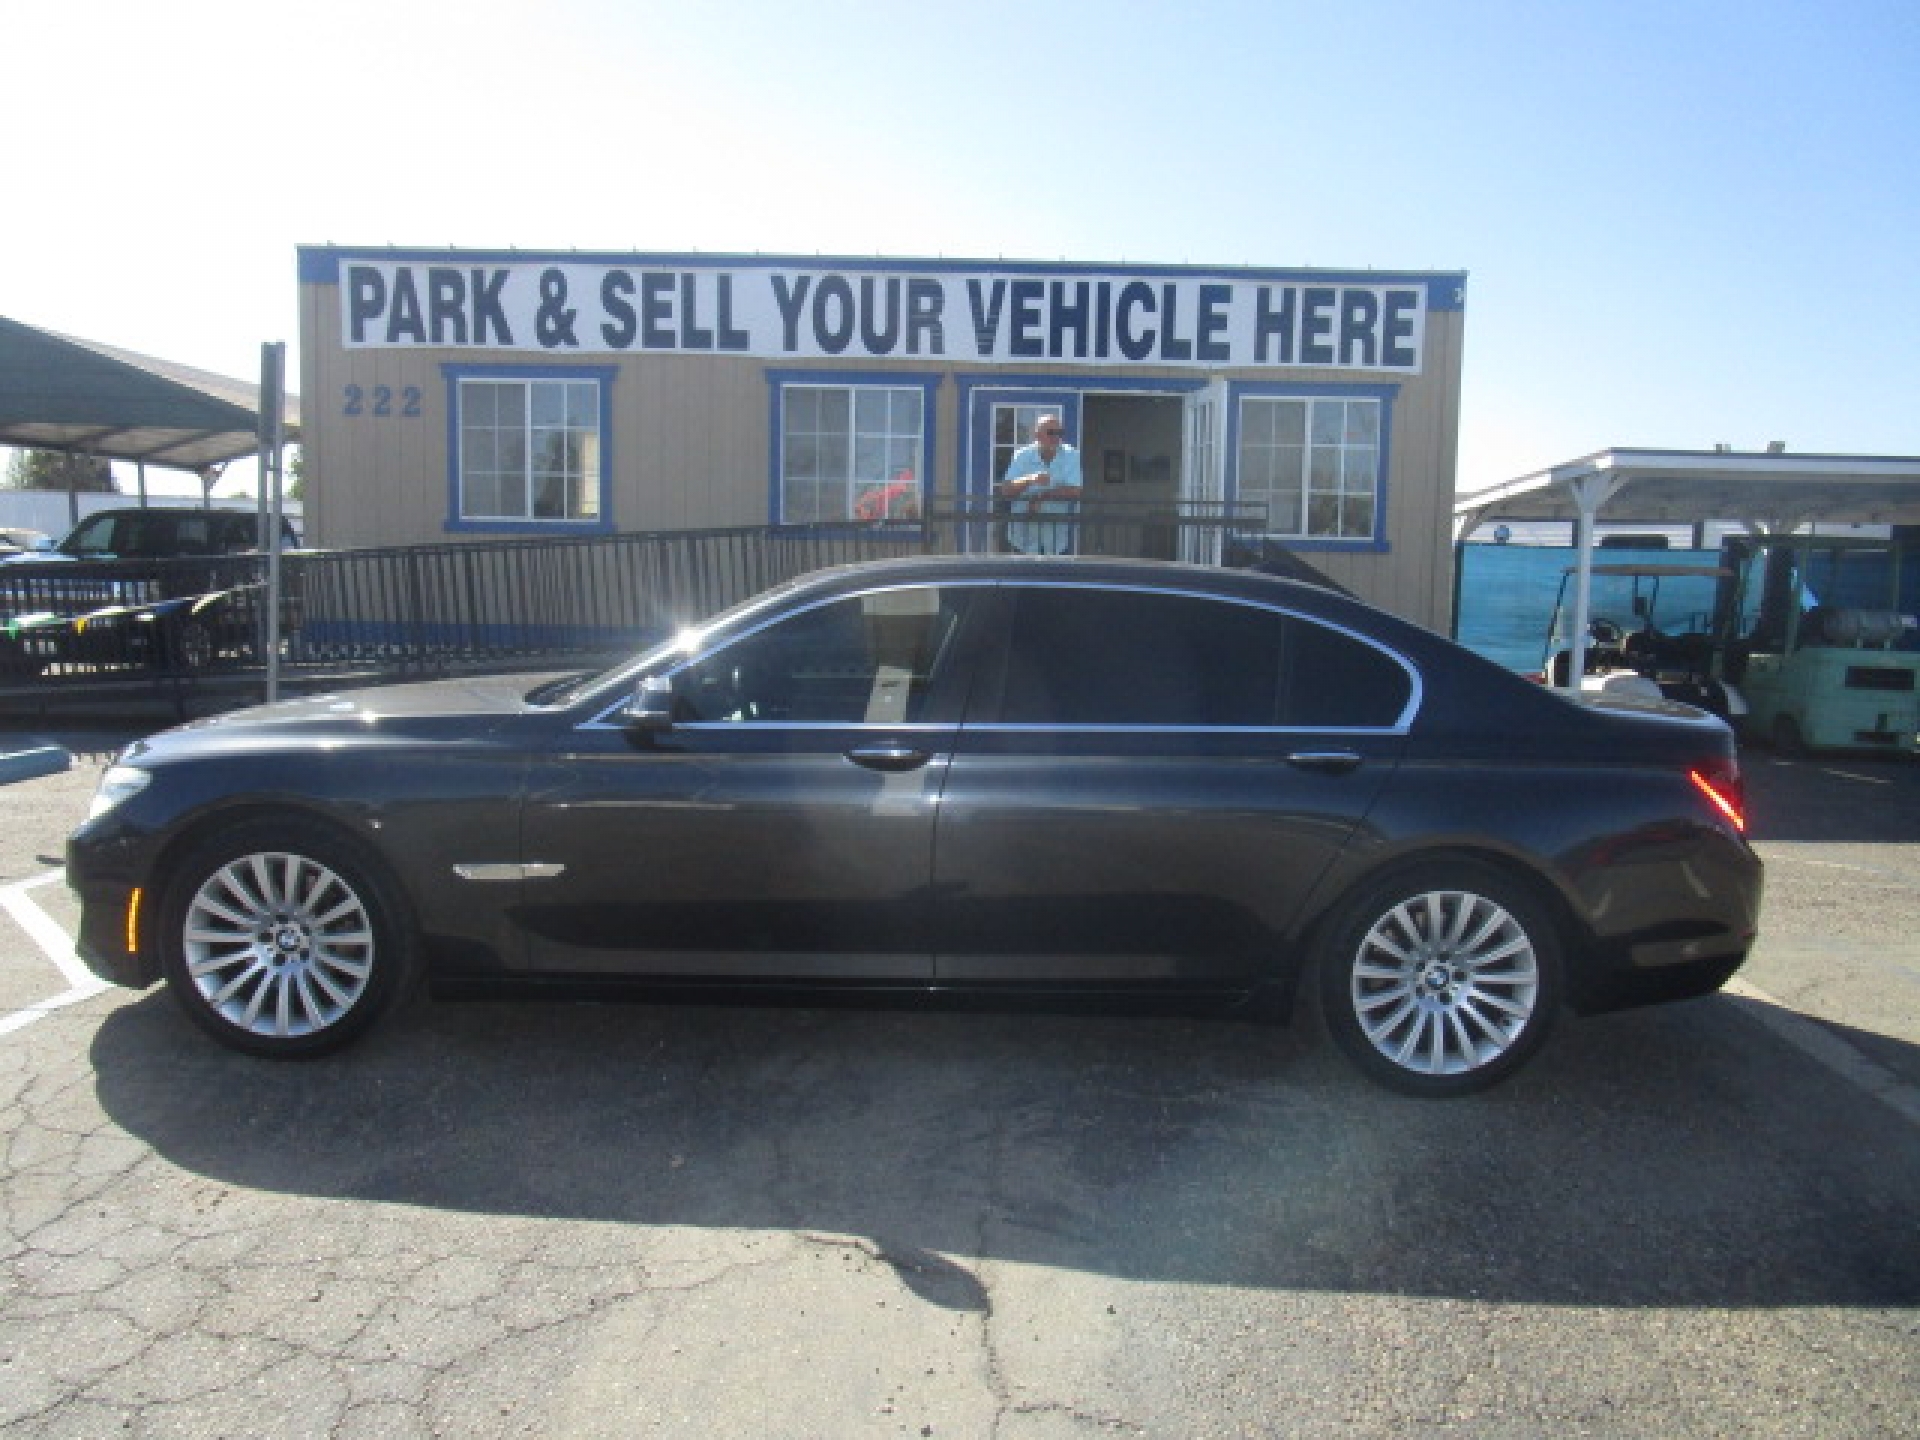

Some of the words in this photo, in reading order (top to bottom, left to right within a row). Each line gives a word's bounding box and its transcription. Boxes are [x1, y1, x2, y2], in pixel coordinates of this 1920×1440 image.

[347, 266, 514, 346] PARK
[535, 268, 580, 348] &
[600, 269, 751, 352] SELL
[770, 274, 945, 356] YOUR
[966, 278, 1233, 361] VEHICLE
[1254, 285, 1418, 367] HERE
[342, 384, 423, 418] 222
